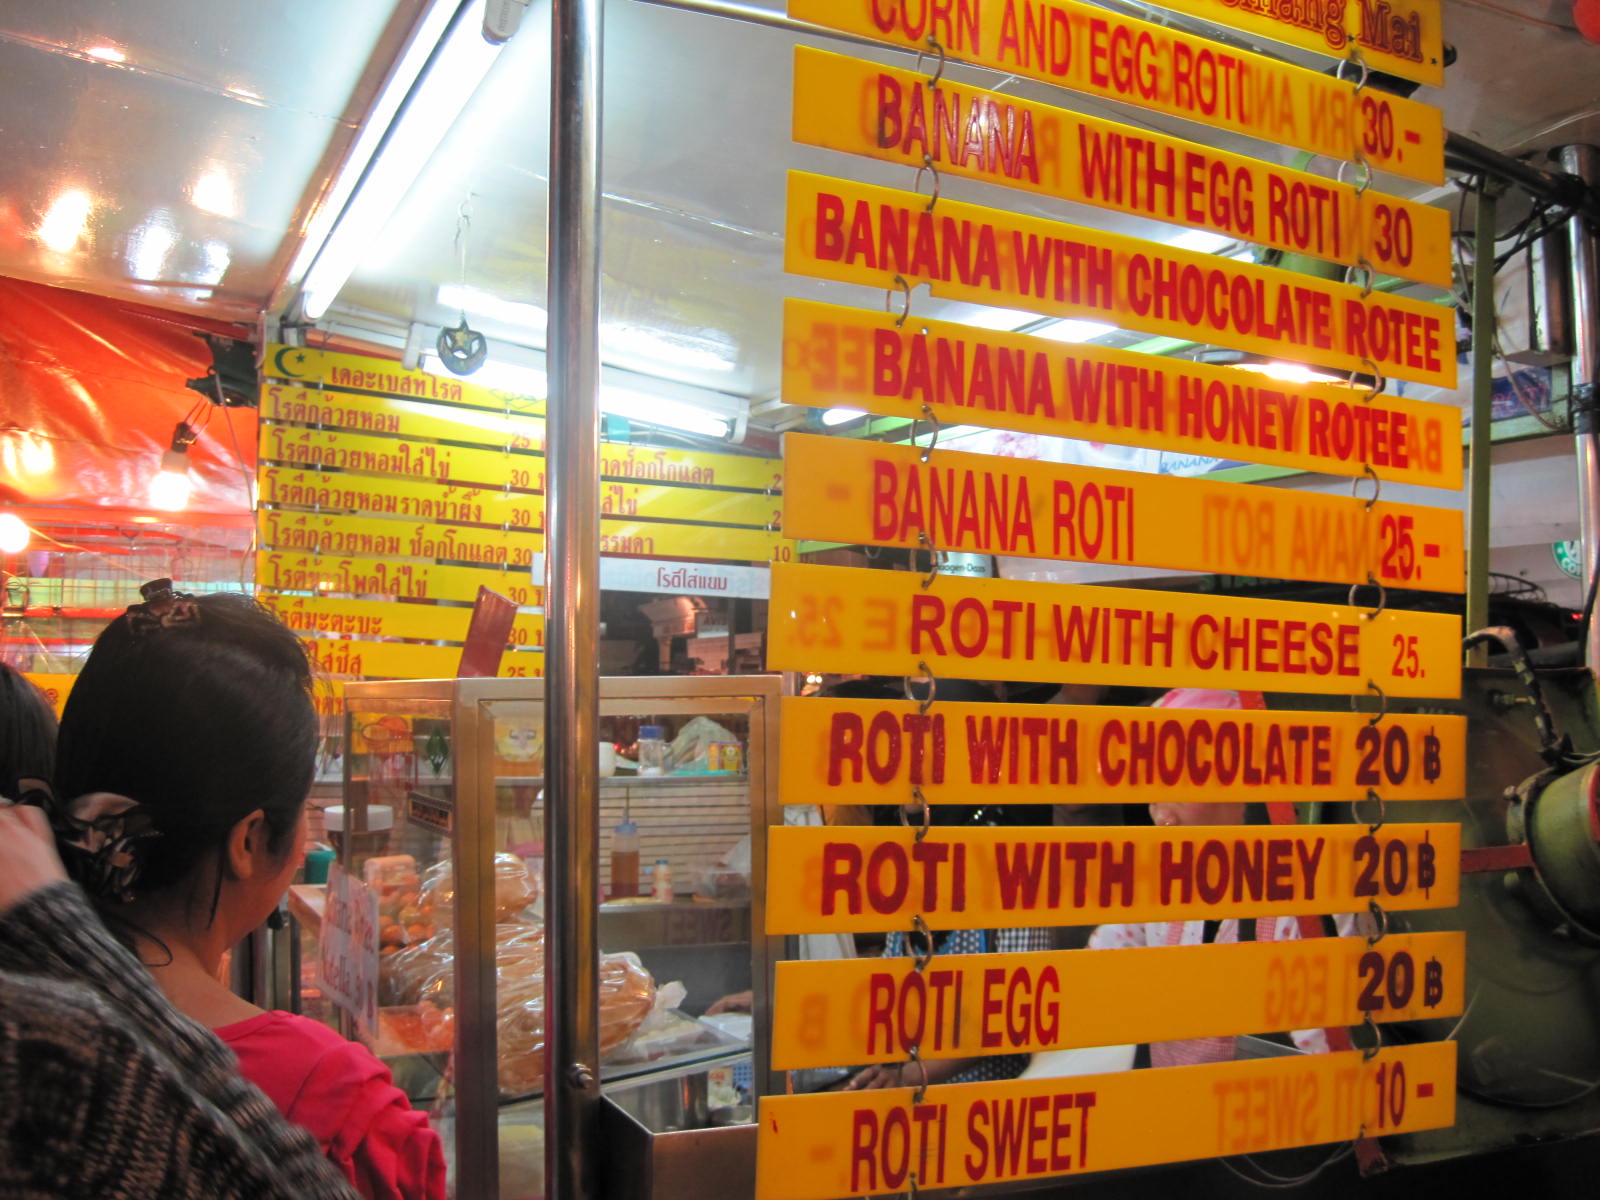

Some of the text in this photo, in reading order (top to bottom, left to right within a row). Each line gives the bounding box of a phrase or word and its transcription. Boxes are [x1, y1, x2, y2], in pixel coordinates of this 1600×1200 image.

[997, 0, 1072, 77] AND
[1089, 17, 1157, 101] EGG
[1173, 40, 1246, 125] ROTI
[1357, 0, 1423, 63] Mai
[877, 72, 1413, 268] BANANA WITH EGG ROTI 30
[815, 192, 1442, 373] BANANA WITH CHOCOLATE ROTEE
[873, 327, 1056, 419] BANANA
[1066, 356, 1164, 433] WITH
[1178, 373, 1302, 453] HONEY
[1308, 397, 1409, 469] ROTEE
[510, 469, 530, 488] 30
[510, 508, 530, 526] 30
[602, 485, 783, 527] ส่ไข่ 2
[773, 473, 783, 490] 2
[872, 459, 1036, 554] BANANA
[1052, 479, 1134, 562] ROTI
[512, 548, 532, 566] 30
[600, 535, 791, 562] รรมดา 10
[508, 586, 528, 605] 30
[306, 640, 362, 674] ใส่ชีส
[910, 594, 1036, 661] ROTI
[1052, 603, 1174, 668] WITH
[1190, 613, 1361, 677] CHEESE
[1391, 634, 1425, 679] 25.
[827, 710, 945, 787] ROTI
[965, 714, 1078, 785] WITH
[1099, 718, 1332, 787] CHOCOLATE
[821, 841, 966, 917] ROTI
[994, 840, 1135, 911] WITH
[1160, 837, 1325, 905] HONEY
[866, 969, 963, 1056] ROTI
[981, 964, 1061, 1048] EGG
[850, 1103, 948, 1193] ROTI
[964, 1090, 1097, 1182] SWEET
